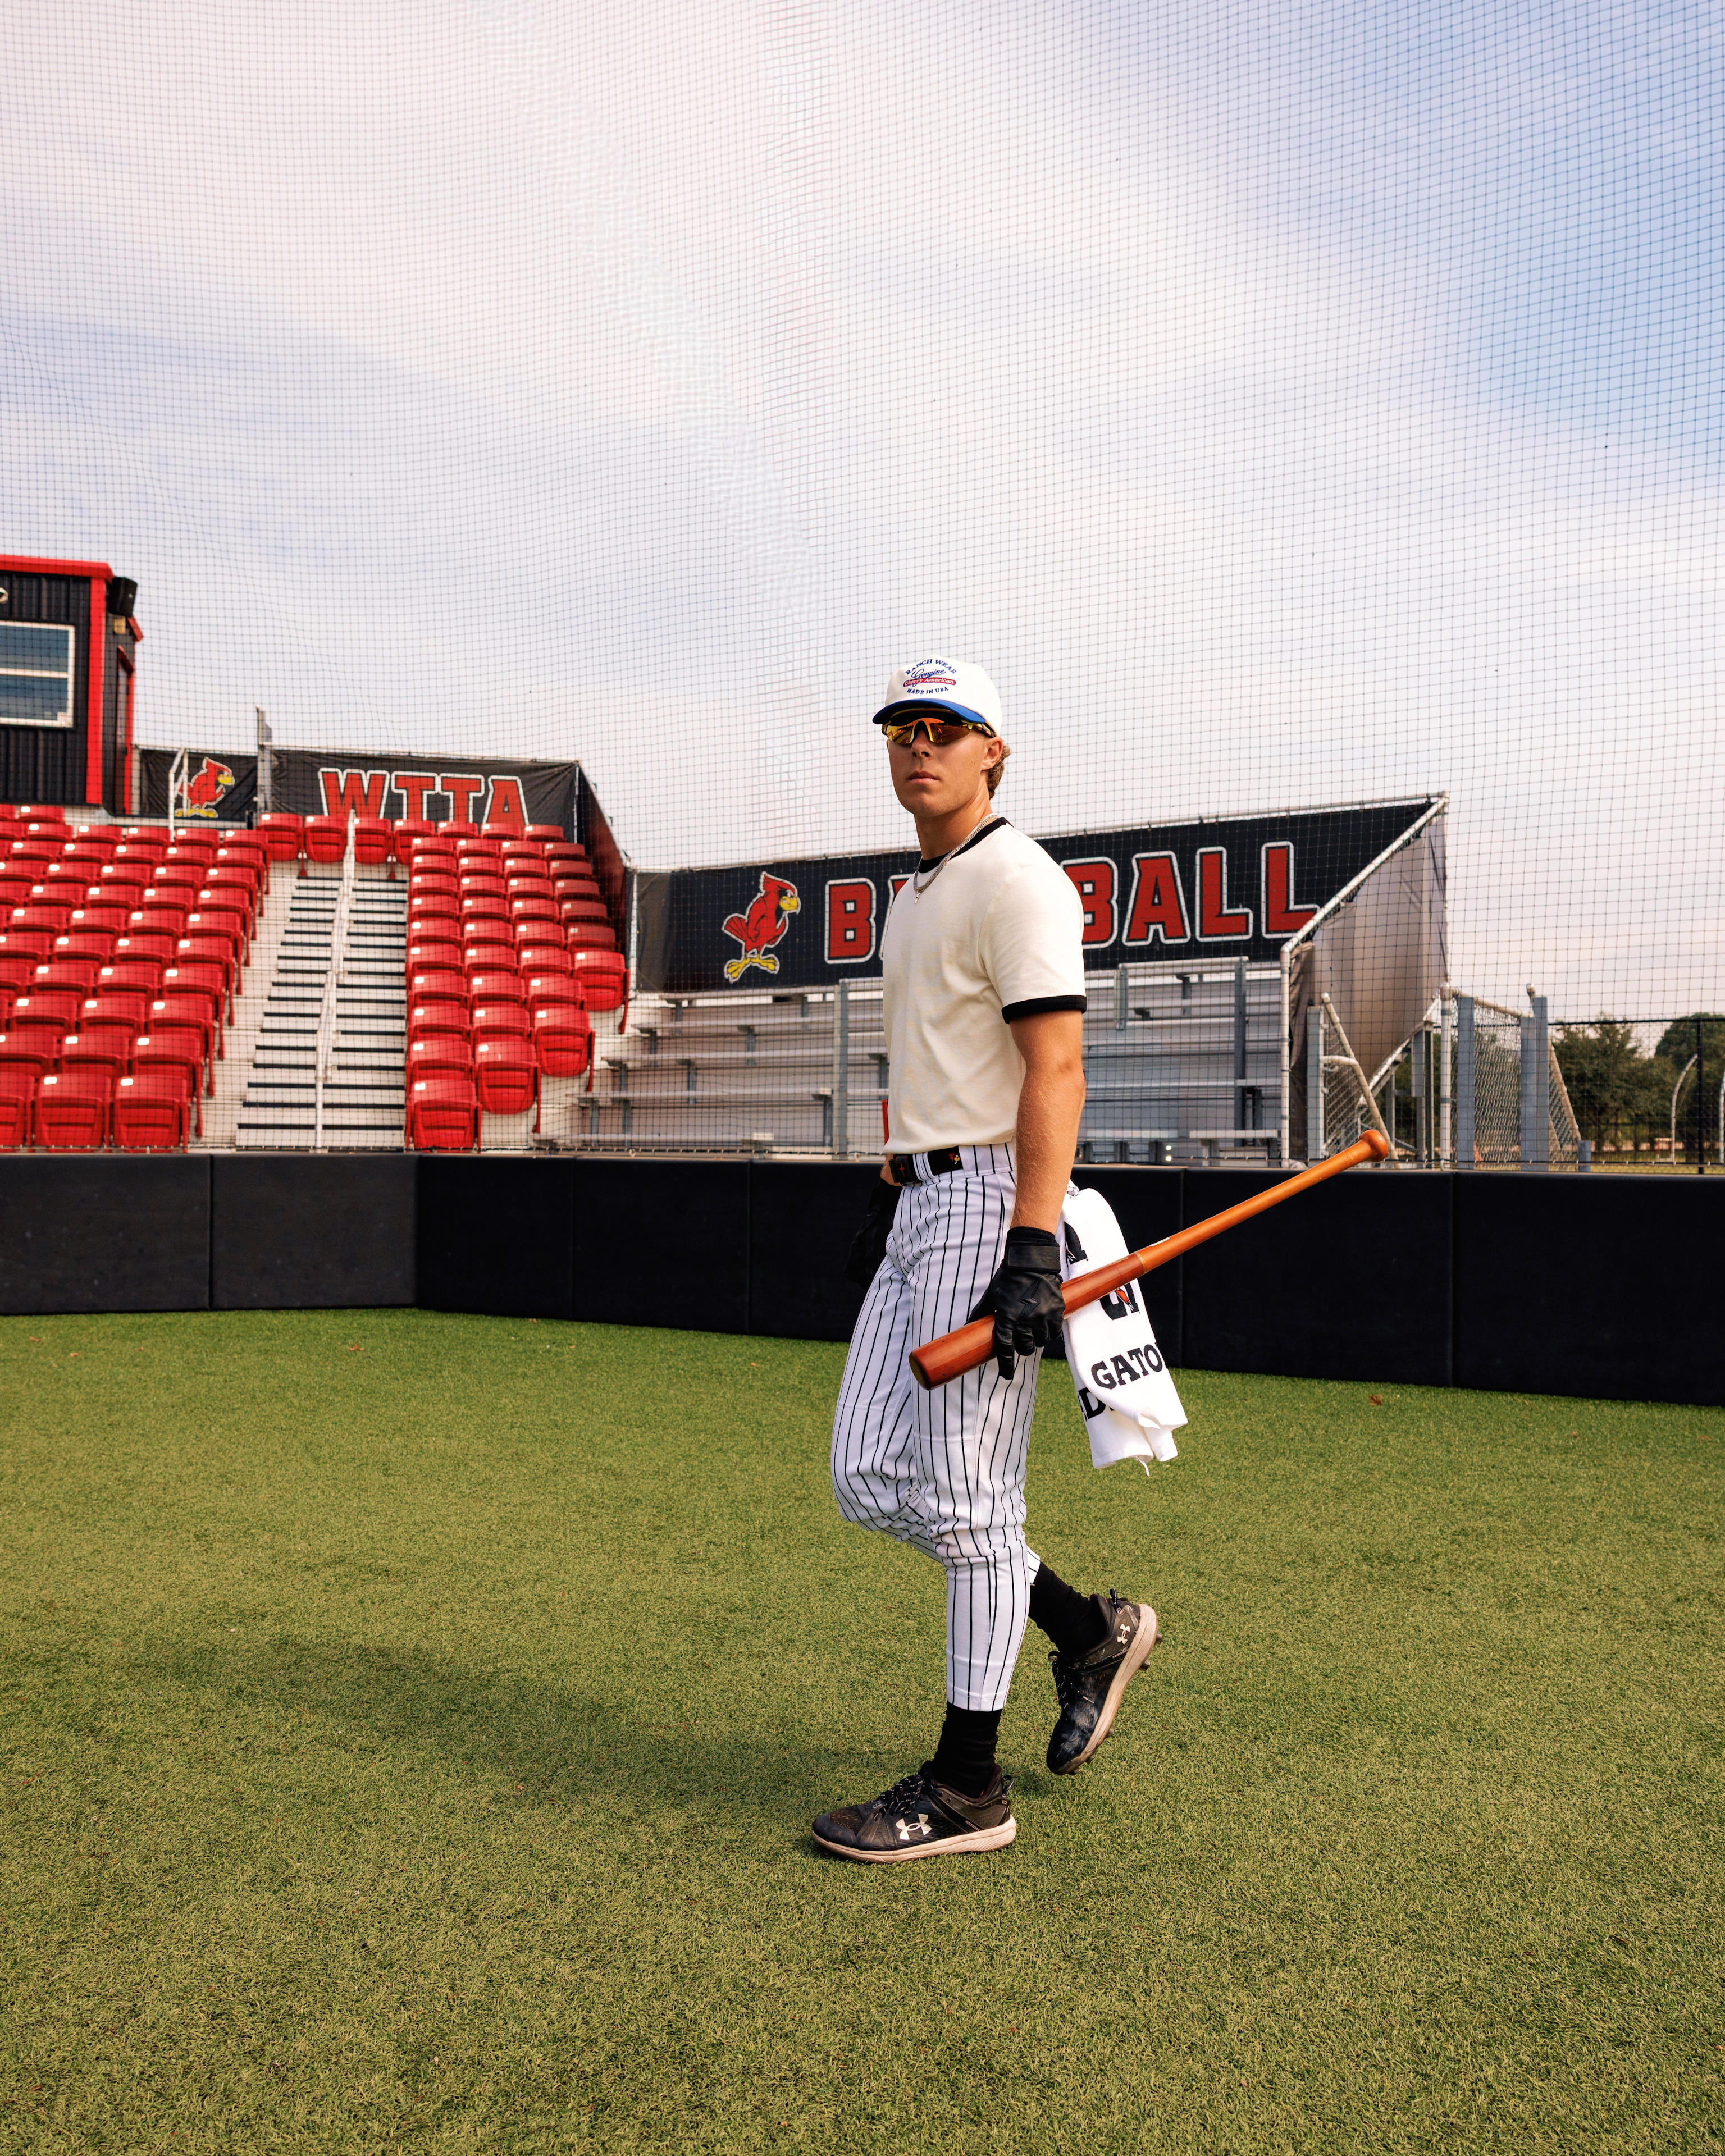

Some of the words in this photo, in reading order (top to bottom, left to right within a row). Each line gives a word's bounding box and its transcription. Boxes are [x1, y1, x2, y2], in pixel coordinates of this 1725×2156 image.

[905, 659, 933, 675] RANCH
[935, 659, 957, 674] WEAR
[911, 668, 947, 680] Genuine
[1091, 1342, 1167, 1390] GATO
